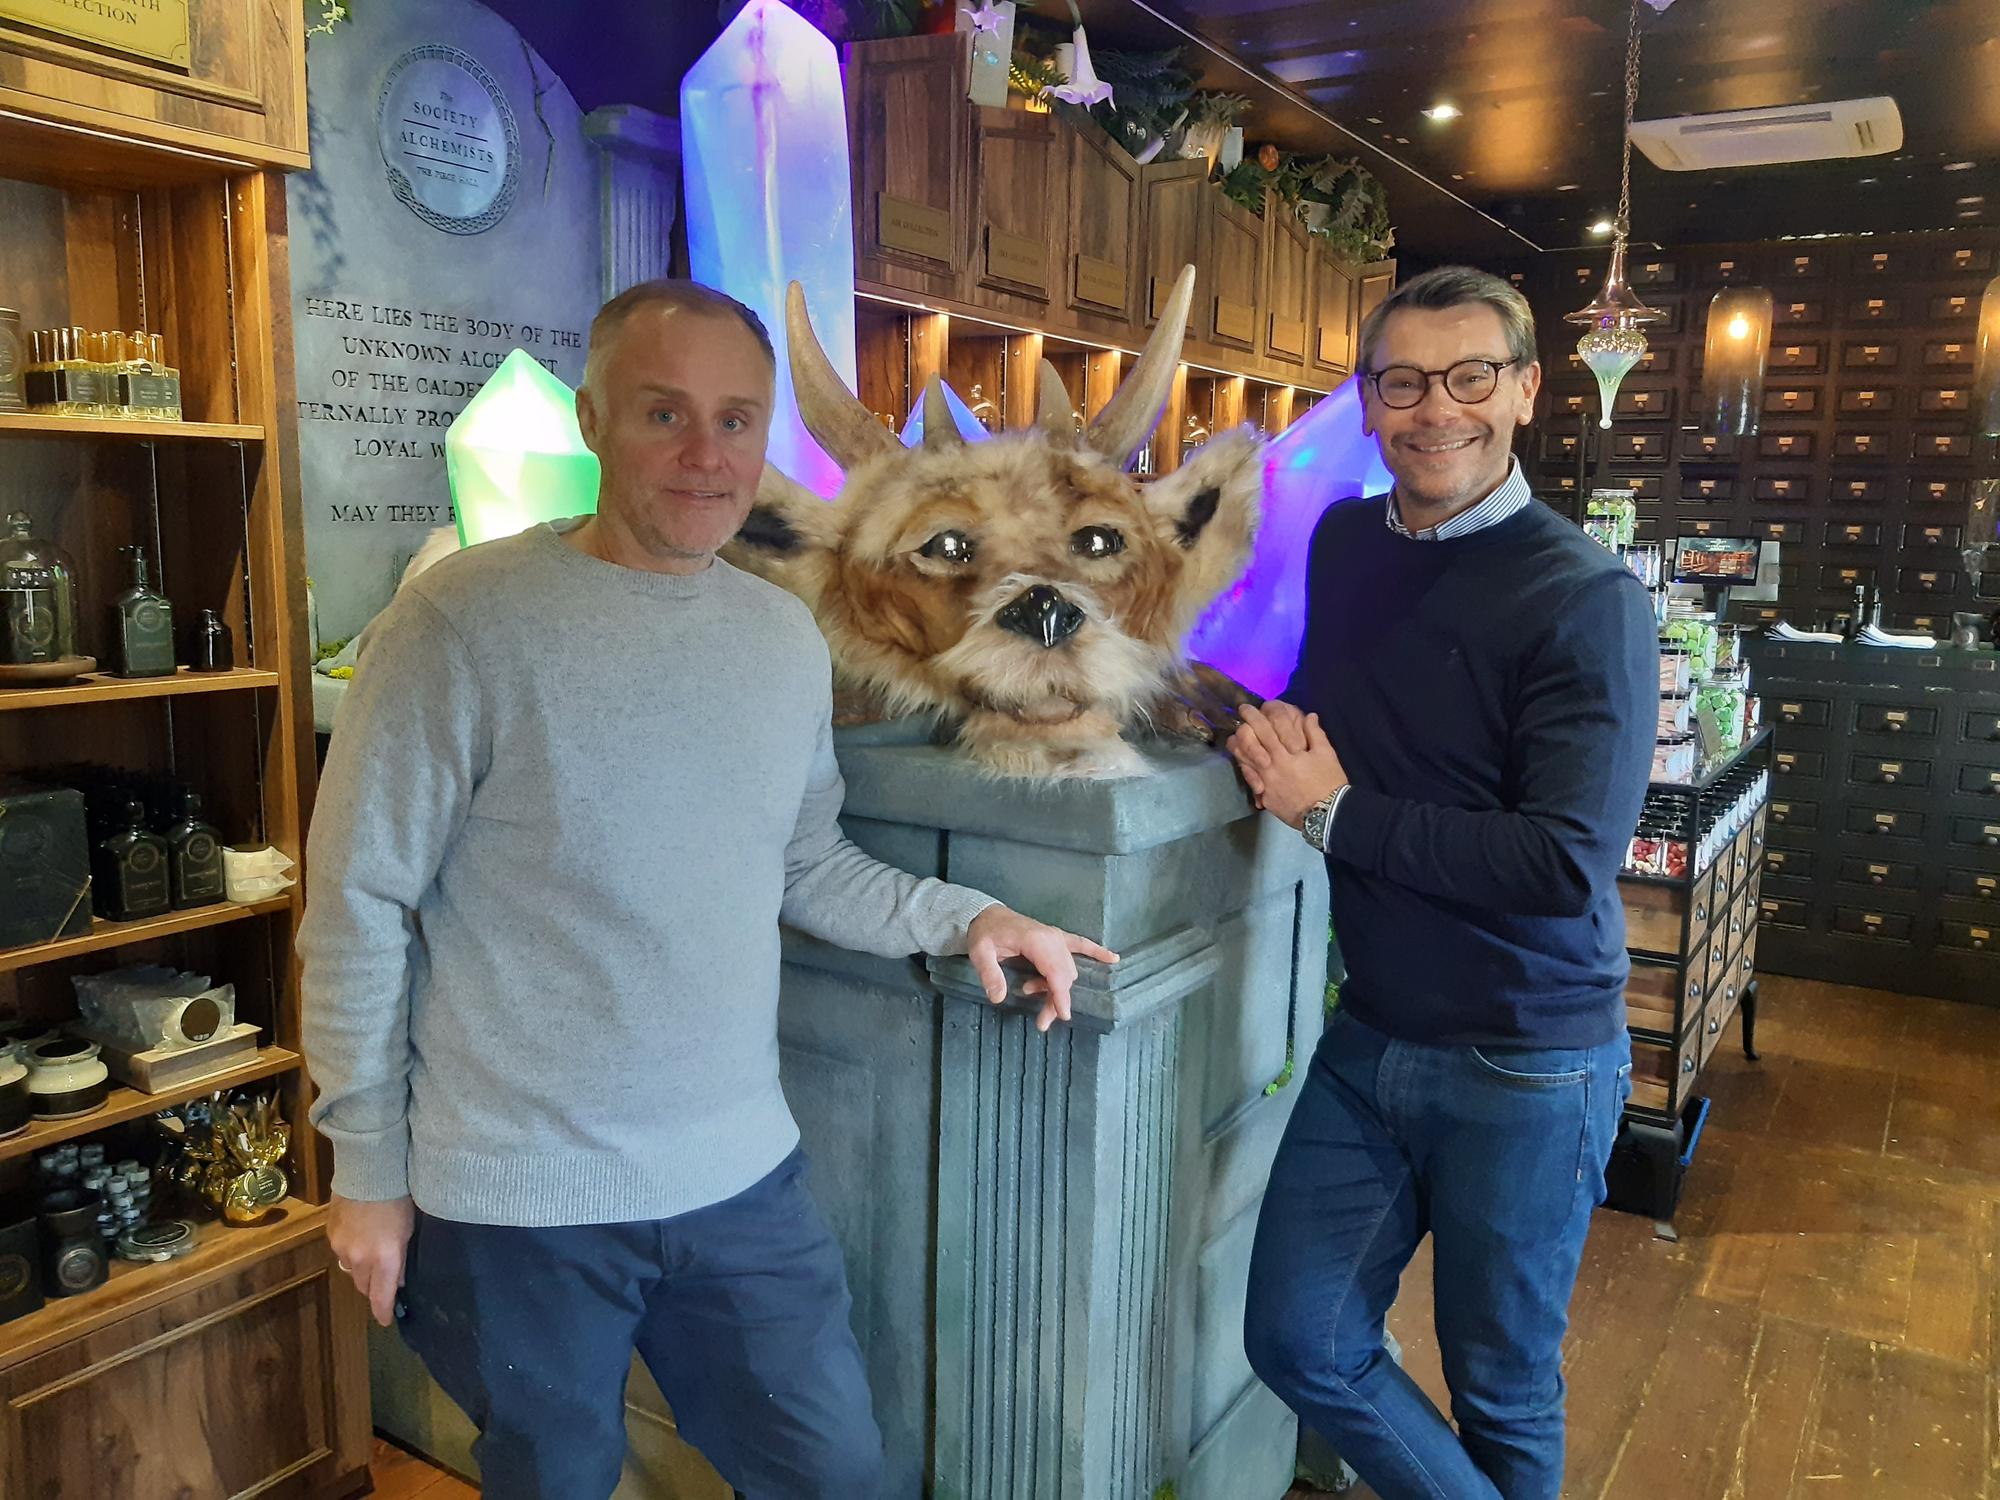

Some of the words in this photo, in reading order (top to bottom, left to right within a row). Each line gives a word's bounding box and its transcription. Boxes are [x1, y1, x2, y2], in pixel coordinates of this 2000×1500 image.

[54, 0, 137, 25] ECTION
[413, 101, 478, 128] SOCIETY
[400, 131, 494, 163] ALCHEMISTS
[306, 297, 363, 321] HERE
[372, 305, 412, 327] LIES
[420, 312, 459, 333] THE
[466, 318, 514, 340] BODY
[521, 325, 543, 343] OF
[550, 329, 581, 348] THE
[342, 336, 451, 364] UNKNOWN
[332, 369, 359, 388] OF
[368, 372, 409, 392] THE
[416, 377, 483, 398] CALDE
[297, 401, 407, 425] TERNALLY
[355, 438, 423, 458] LOYAL
[330, 504, 378, 522] MAY
[387, 505, 440, 522] THEY
